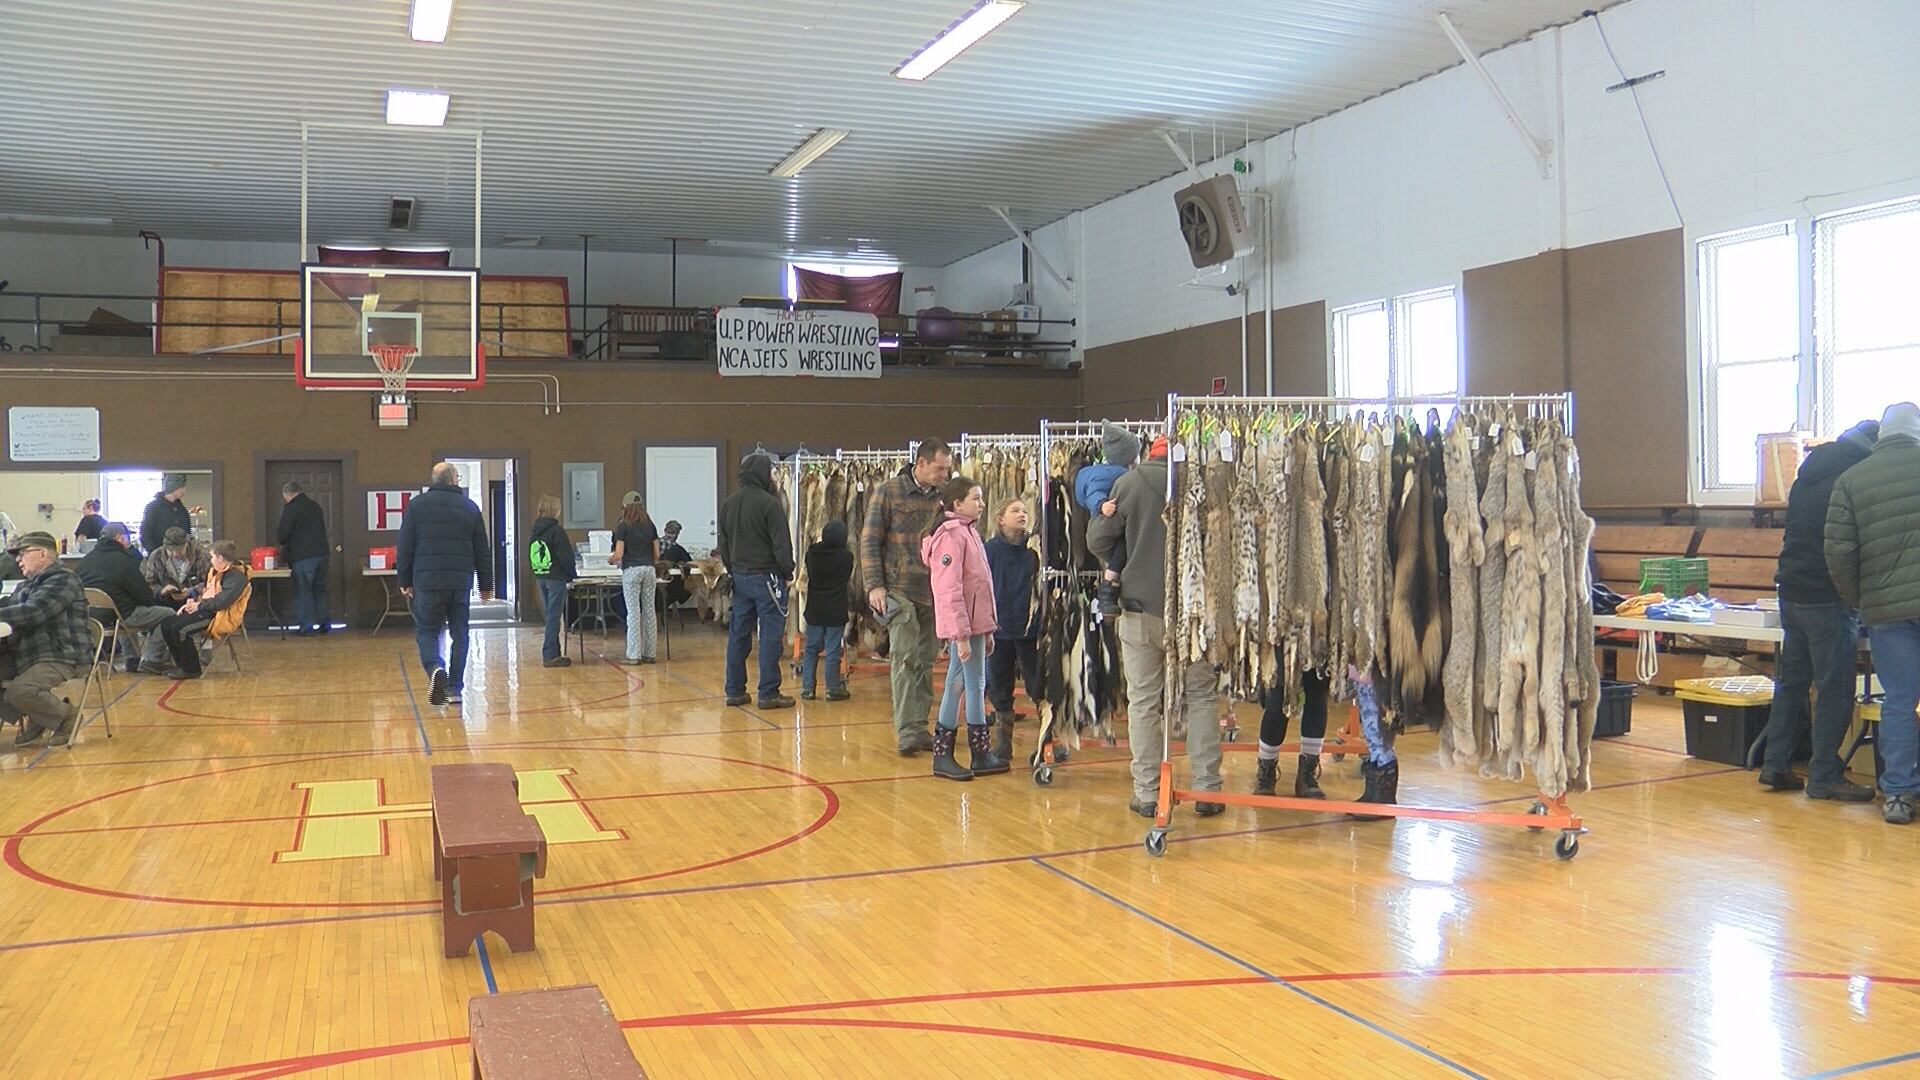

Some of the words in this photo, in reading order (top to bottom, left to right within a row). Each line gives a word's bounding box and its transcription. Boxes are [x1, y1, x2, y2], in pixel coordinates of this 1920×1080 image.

[776, 310, 804, 321] HOME
[804, 310, 817, 321] OF
[719, 318, 744, 341] U.P.
[747, 319, 795, 345] POWER
[798, 322, 878, 347] WRESTLING
[798, 349, 876, 371] WRESTLING
